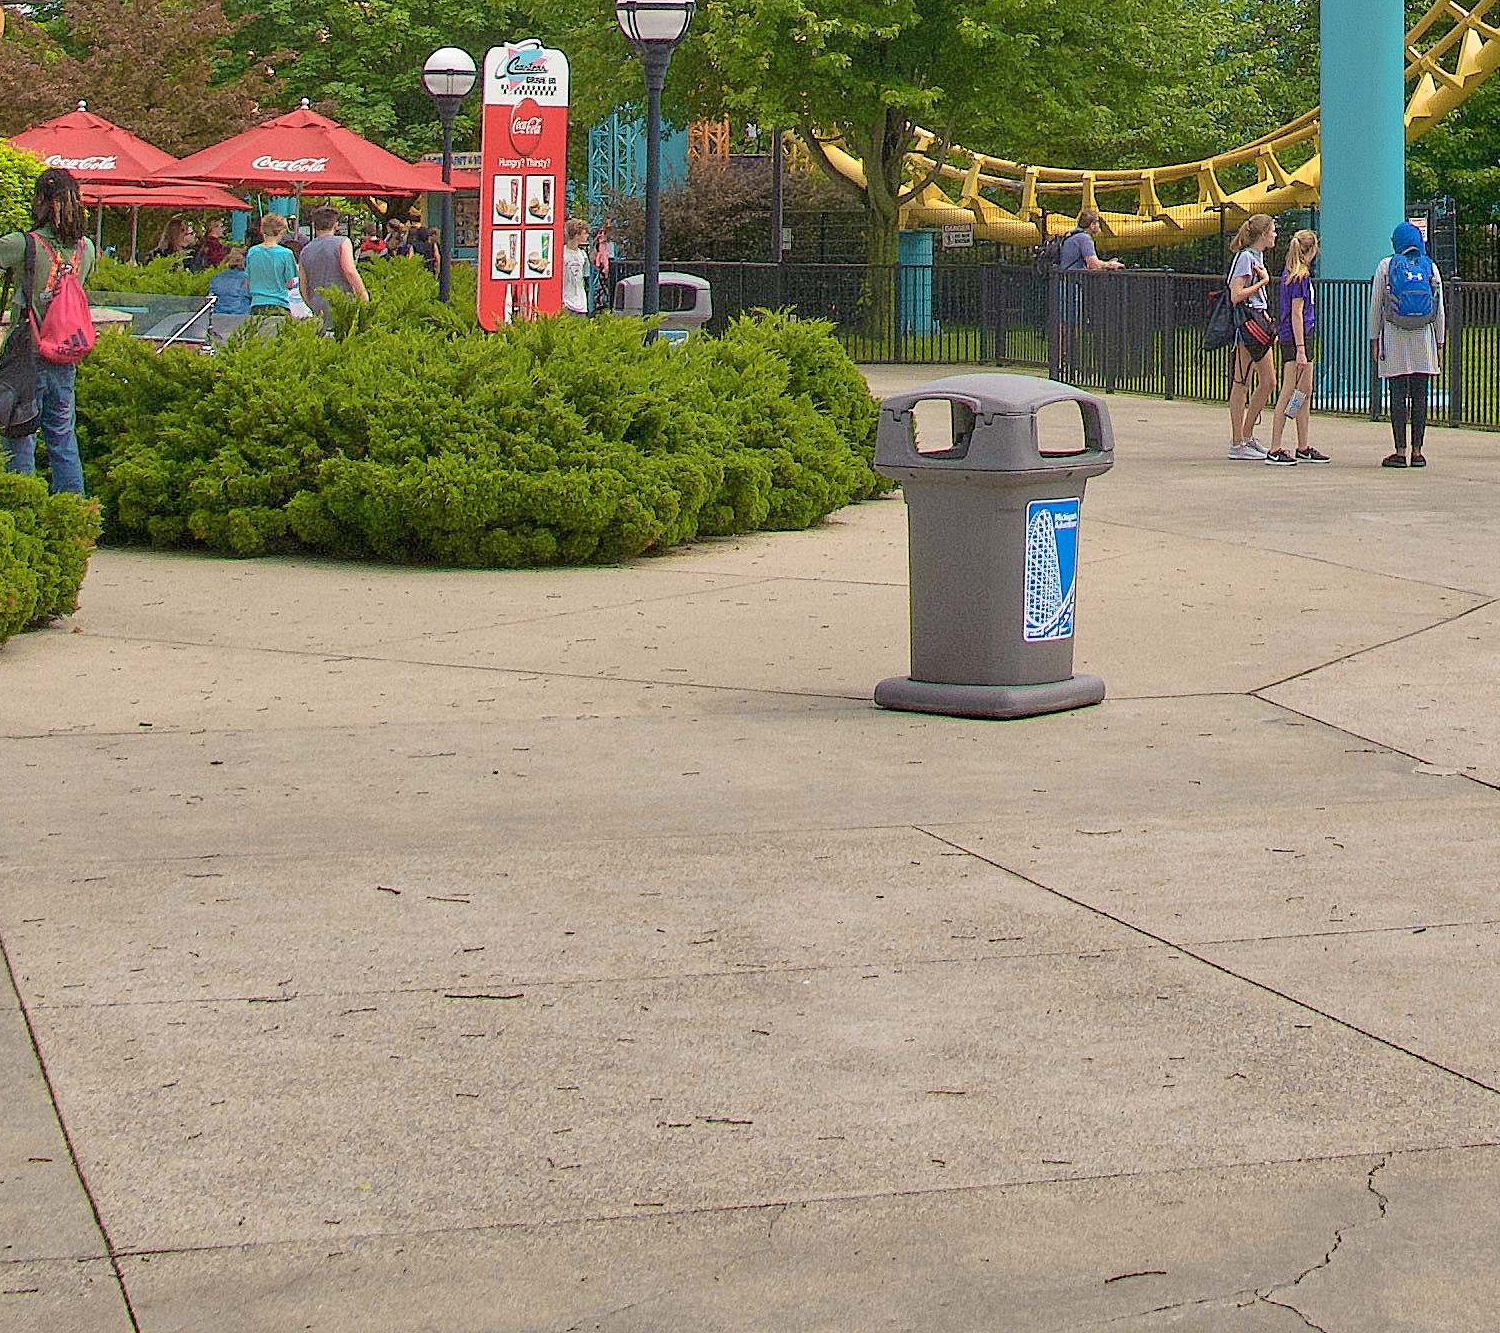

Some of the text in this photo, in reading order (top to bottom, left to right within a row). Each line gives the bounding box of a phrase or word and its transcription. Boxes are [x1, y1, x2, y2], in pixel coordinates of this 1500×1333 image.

[45, 154, 118, 171] Coca-Cola
[251, 155, 329, 172] Coca-Cola
[498, 157, 552, 169] Hungry? Thirsty?
